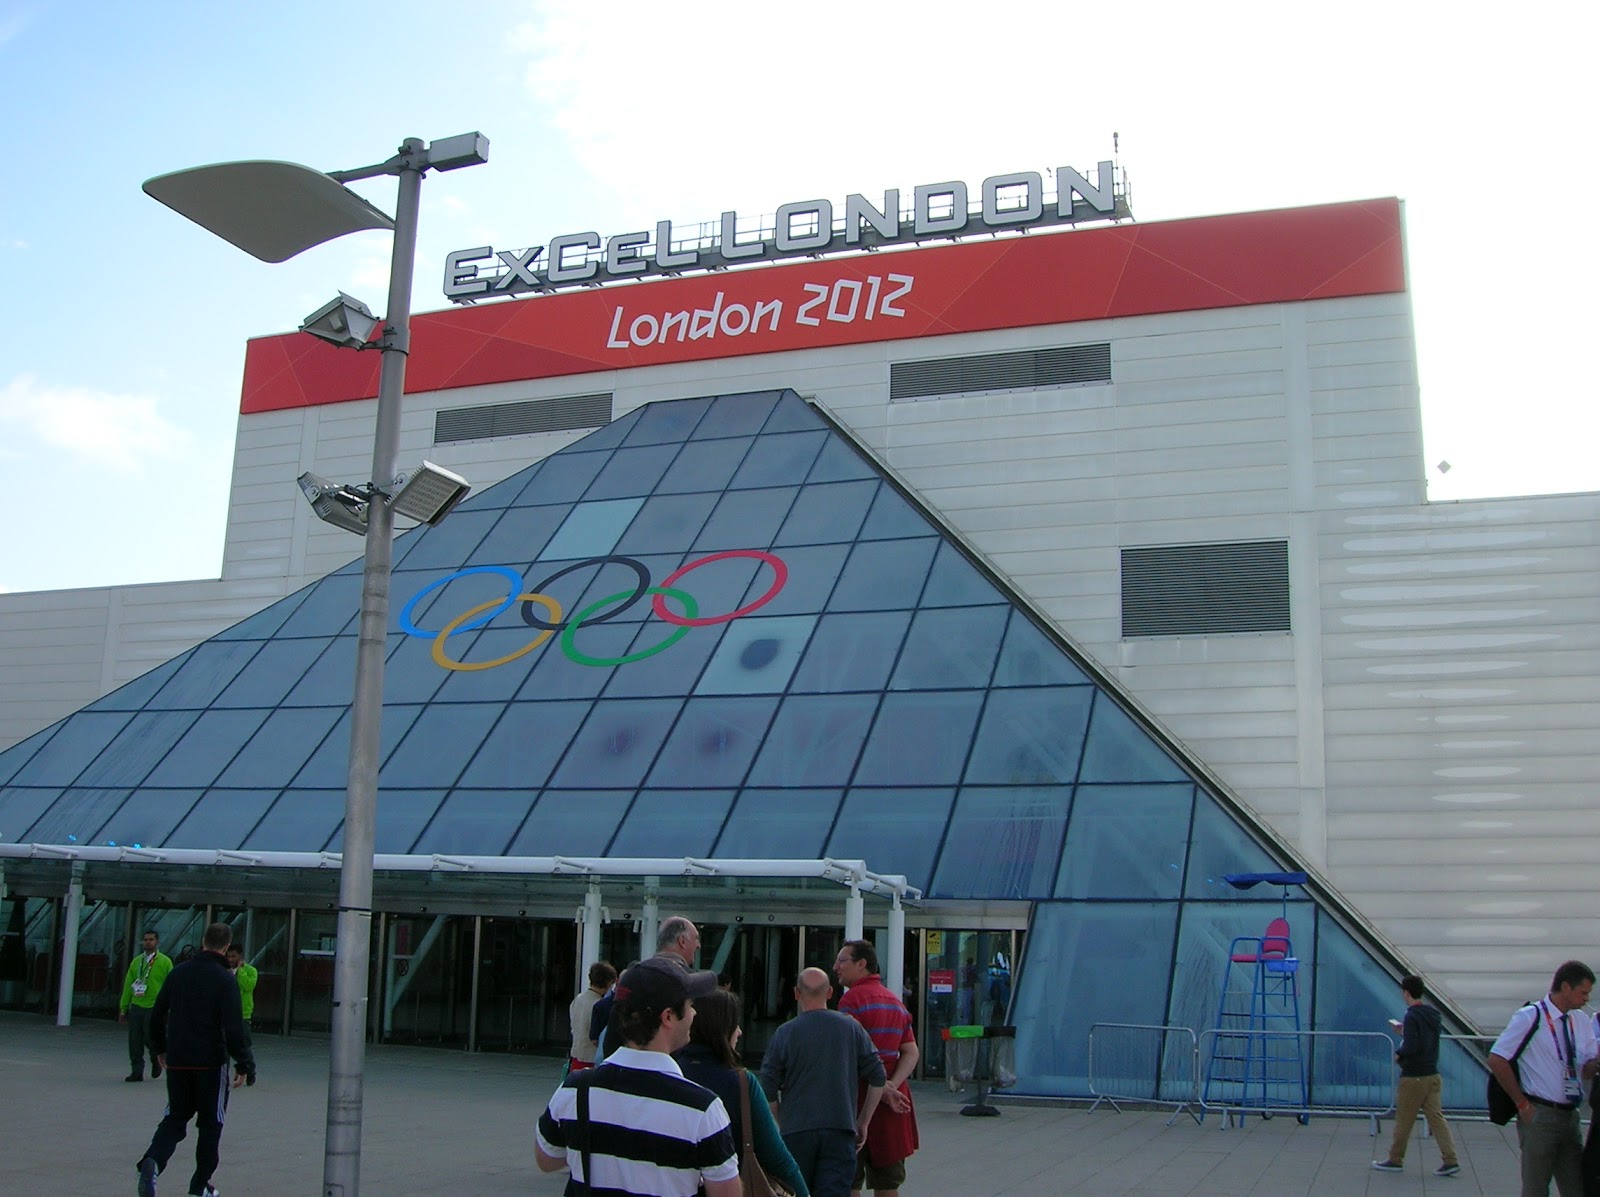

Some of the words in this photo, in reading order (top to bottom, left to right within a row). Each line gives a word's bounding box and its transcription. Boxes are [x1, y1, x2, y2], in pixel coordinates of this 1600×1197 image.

[721, 161, 1116, 259] LONDON
[607, 292, 783, 348] London
[796, 273, 914, 326] 2012
